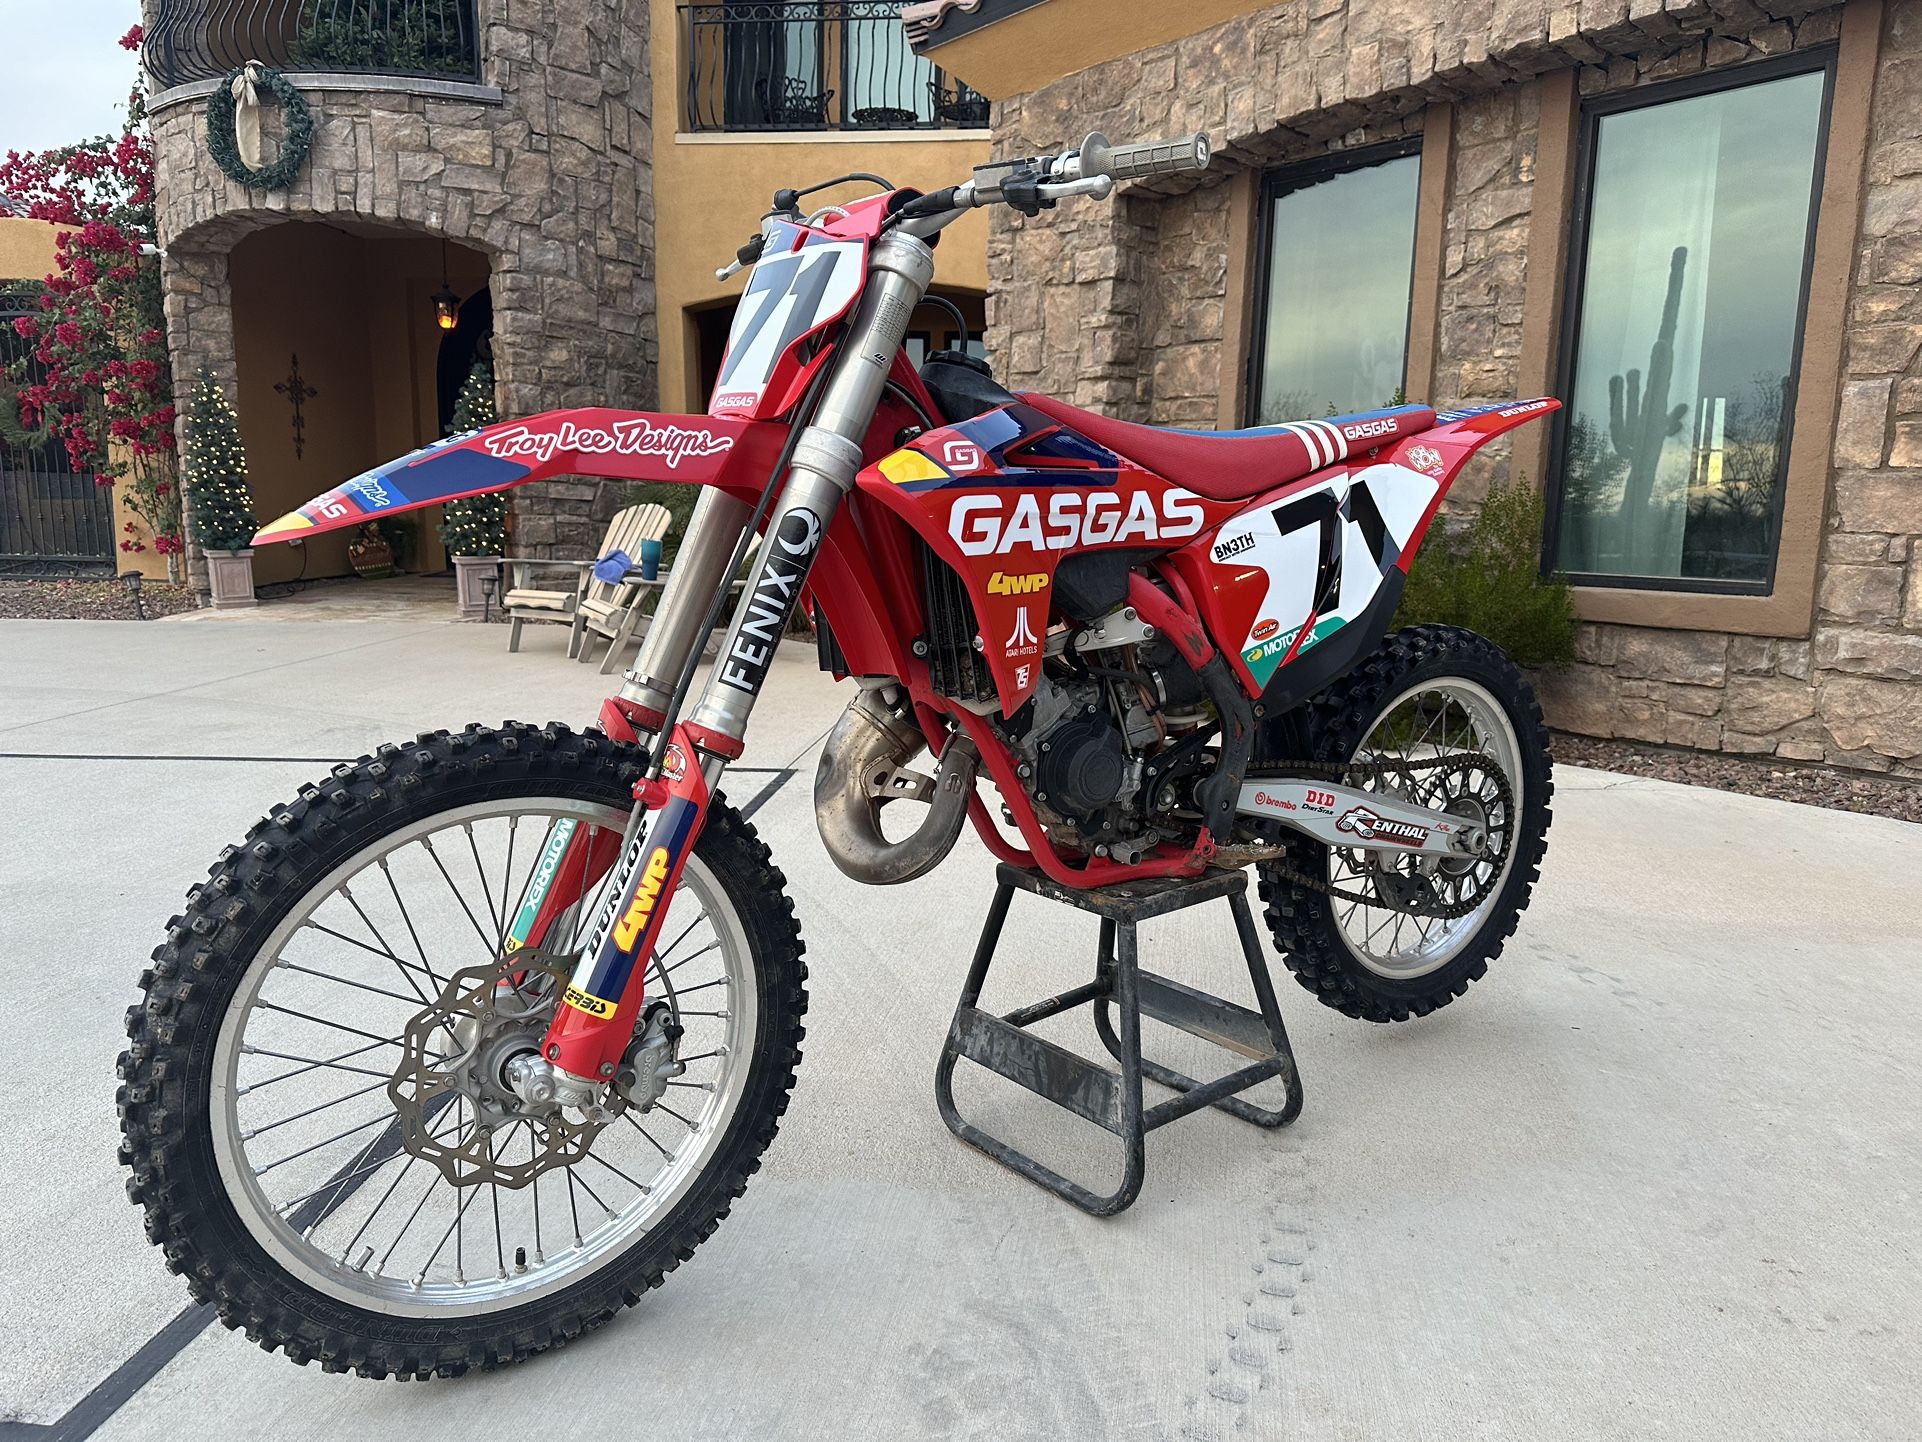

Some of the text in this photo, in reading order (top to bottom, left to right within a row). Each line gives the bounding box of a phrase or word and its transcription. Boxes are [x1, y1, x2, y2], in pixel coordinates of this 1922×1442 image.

[720, 251, 842, 387] 71
[716, 395, 755, 408] GASGAS
[1498, 401, 1550, 418] DUNLOP
[485, 426, 558, 462] Troy
[557, 422, 615, 455] Lee
[613, 418, 734, 469] Designs
[1344, 418, 1398, 439] GASGAS
[948, 488, 1205, 557] GASGAS
[1214, 531, 1255, 559] BN3TH
[1271, 479, 1402, 617] 71
[987, 571, 1049, 596] 4WP
[721, 562, 797, 691] FENIX
[1253, 621, 1277, 639] Twin Air
[1005, 645, 1037, 659] ATARI HOTELS
[1266, 796, 1297, 811] brembo
[525, 816, 574, 912] MOTOREX
[588, 818, 648, 961] DUNLOP
[611, 846, 671, 954] 4WP
